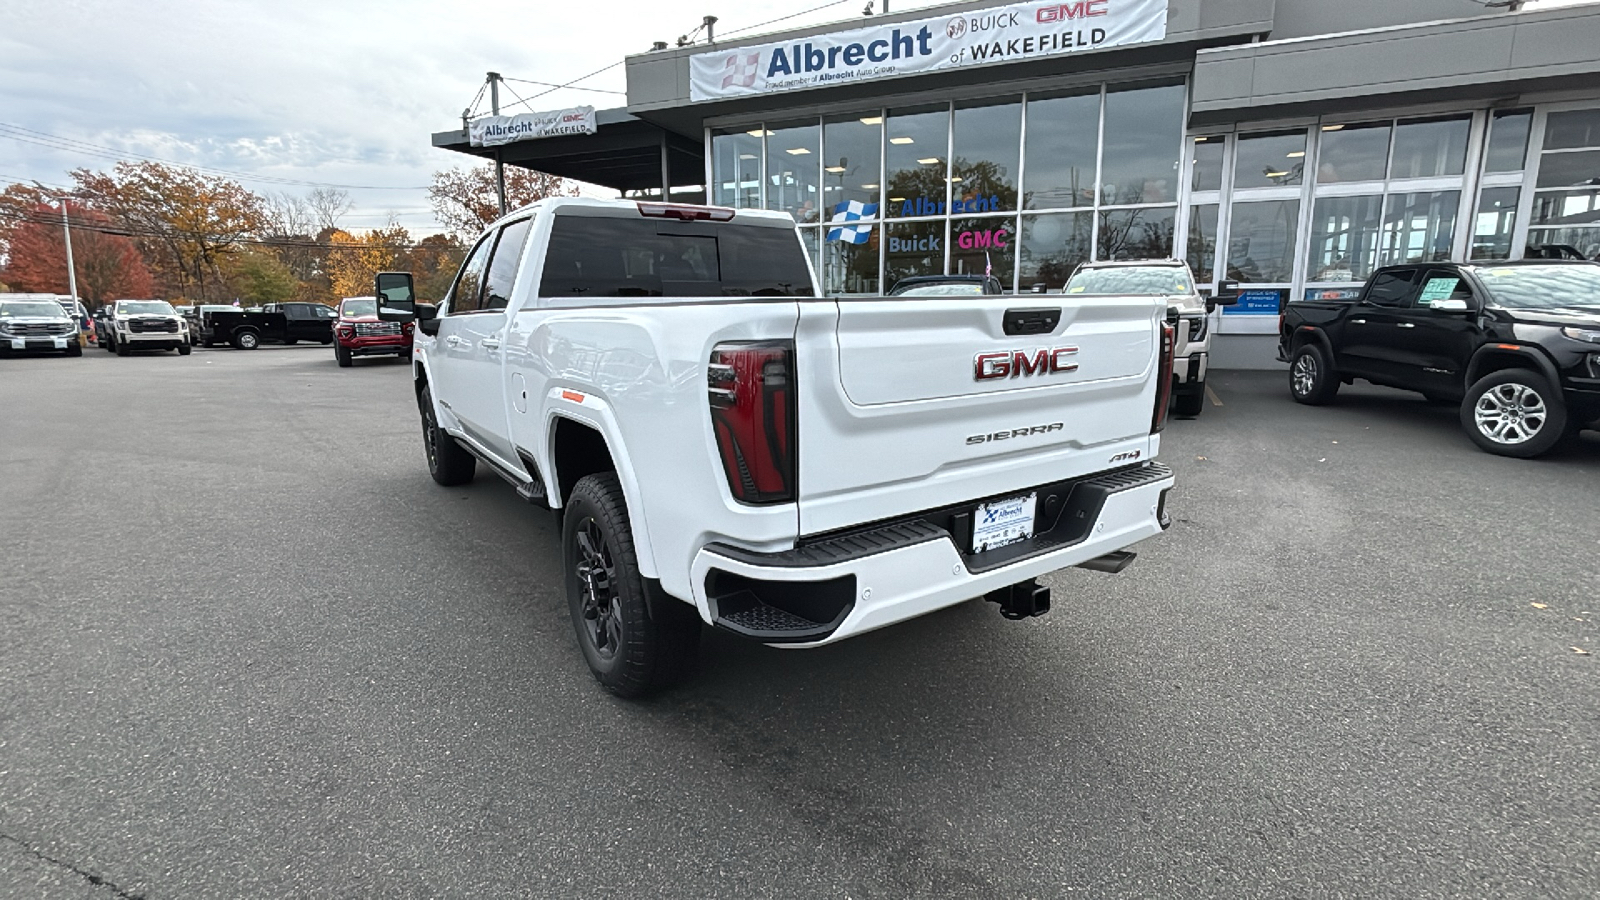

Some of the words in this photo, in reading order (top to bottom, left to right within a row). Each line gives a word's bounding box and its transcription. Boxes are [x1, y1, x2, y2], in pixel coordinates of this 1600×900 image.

[970, 11, 1019, 32] BUICK
[1036, 0, 1107, 24] GMC
[767, 25, 932, 78] Albrecht
[950, 47, 965, 63] of
[970, 28, 1106, 60] WAKEFIELD
[765, 79, 783, 89] Proud
[784, 76, 810, 87] member
[811, 75, 818, 83] of
[819, 70, 854, 82] Albrecht
[856, 67, 872, 77] Auto
[874, 65, 896, 74] Group
[484, 121, 533, 136] Albrecht
[544, 124, 587, 136] WAKEFIELD
[563, 114, 585, 122] GMC
[901, 193, 1000, 216] Albrecht
[889, 234, 940, 253] Buick
[958, 229, 1008, 249] GMC
[973, 345, 1080, 382] GMC
[965, 421, 1064, 445] SIERRA
[1108, 449, 1142, 463] AT4
[999, 506, 1022, 518] Albrecht
